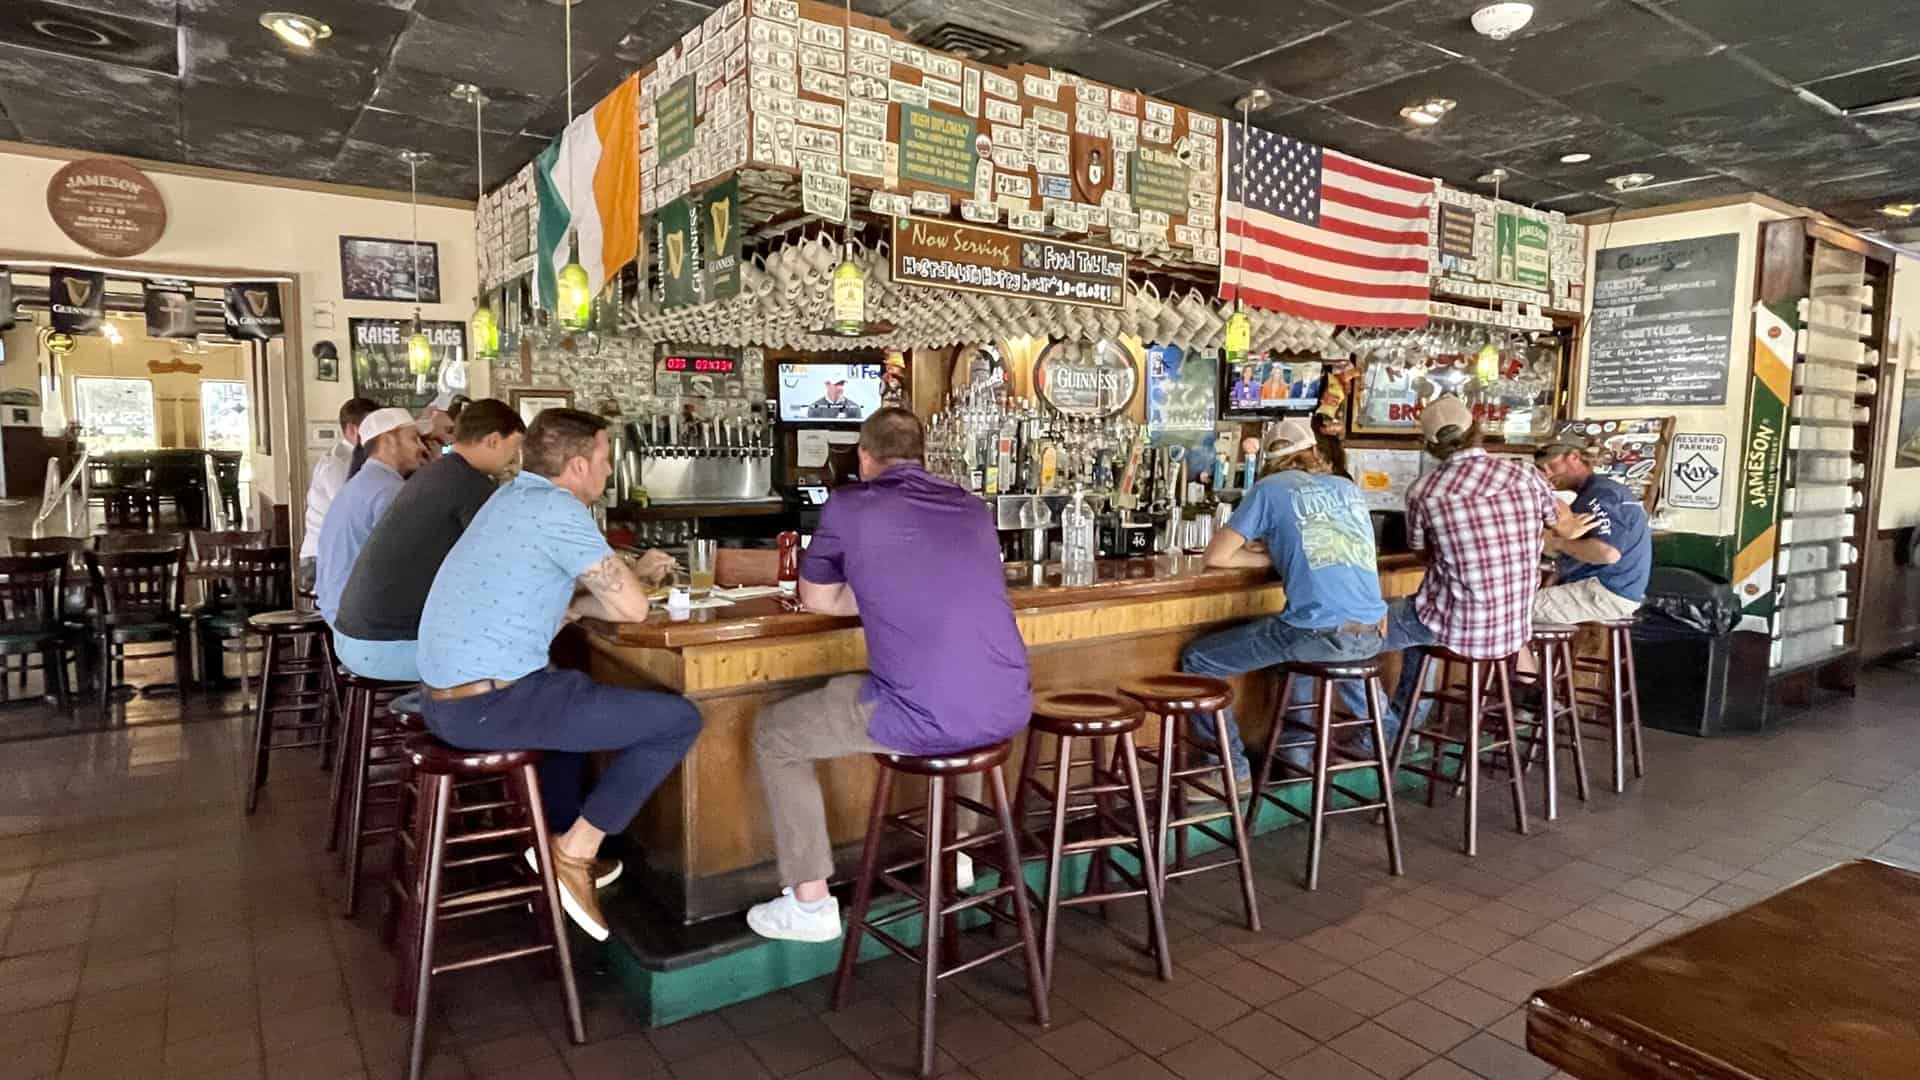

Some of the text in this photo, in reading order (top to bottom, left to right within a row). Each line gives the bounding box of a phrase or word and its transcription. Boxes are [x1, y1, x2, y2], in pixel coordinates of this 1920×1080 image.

[65, 175, 145, 195] JAMESON
[690, 207, 703, 293] GUINNESS
[912, 224, 1010, 266] Now Serving
[1044, 246, 1075, 271] Food
[53, 303, 98, 316] GUINNESS
[357, 327, 400, 344] RAISE
[1057, 367, 1118, 390] GUINNESS
[1676, 436, 1723, 444] RESERVED
[1750, 425, 1775, 509] JAMESON
[1132, 536, 1146, 547] 46
